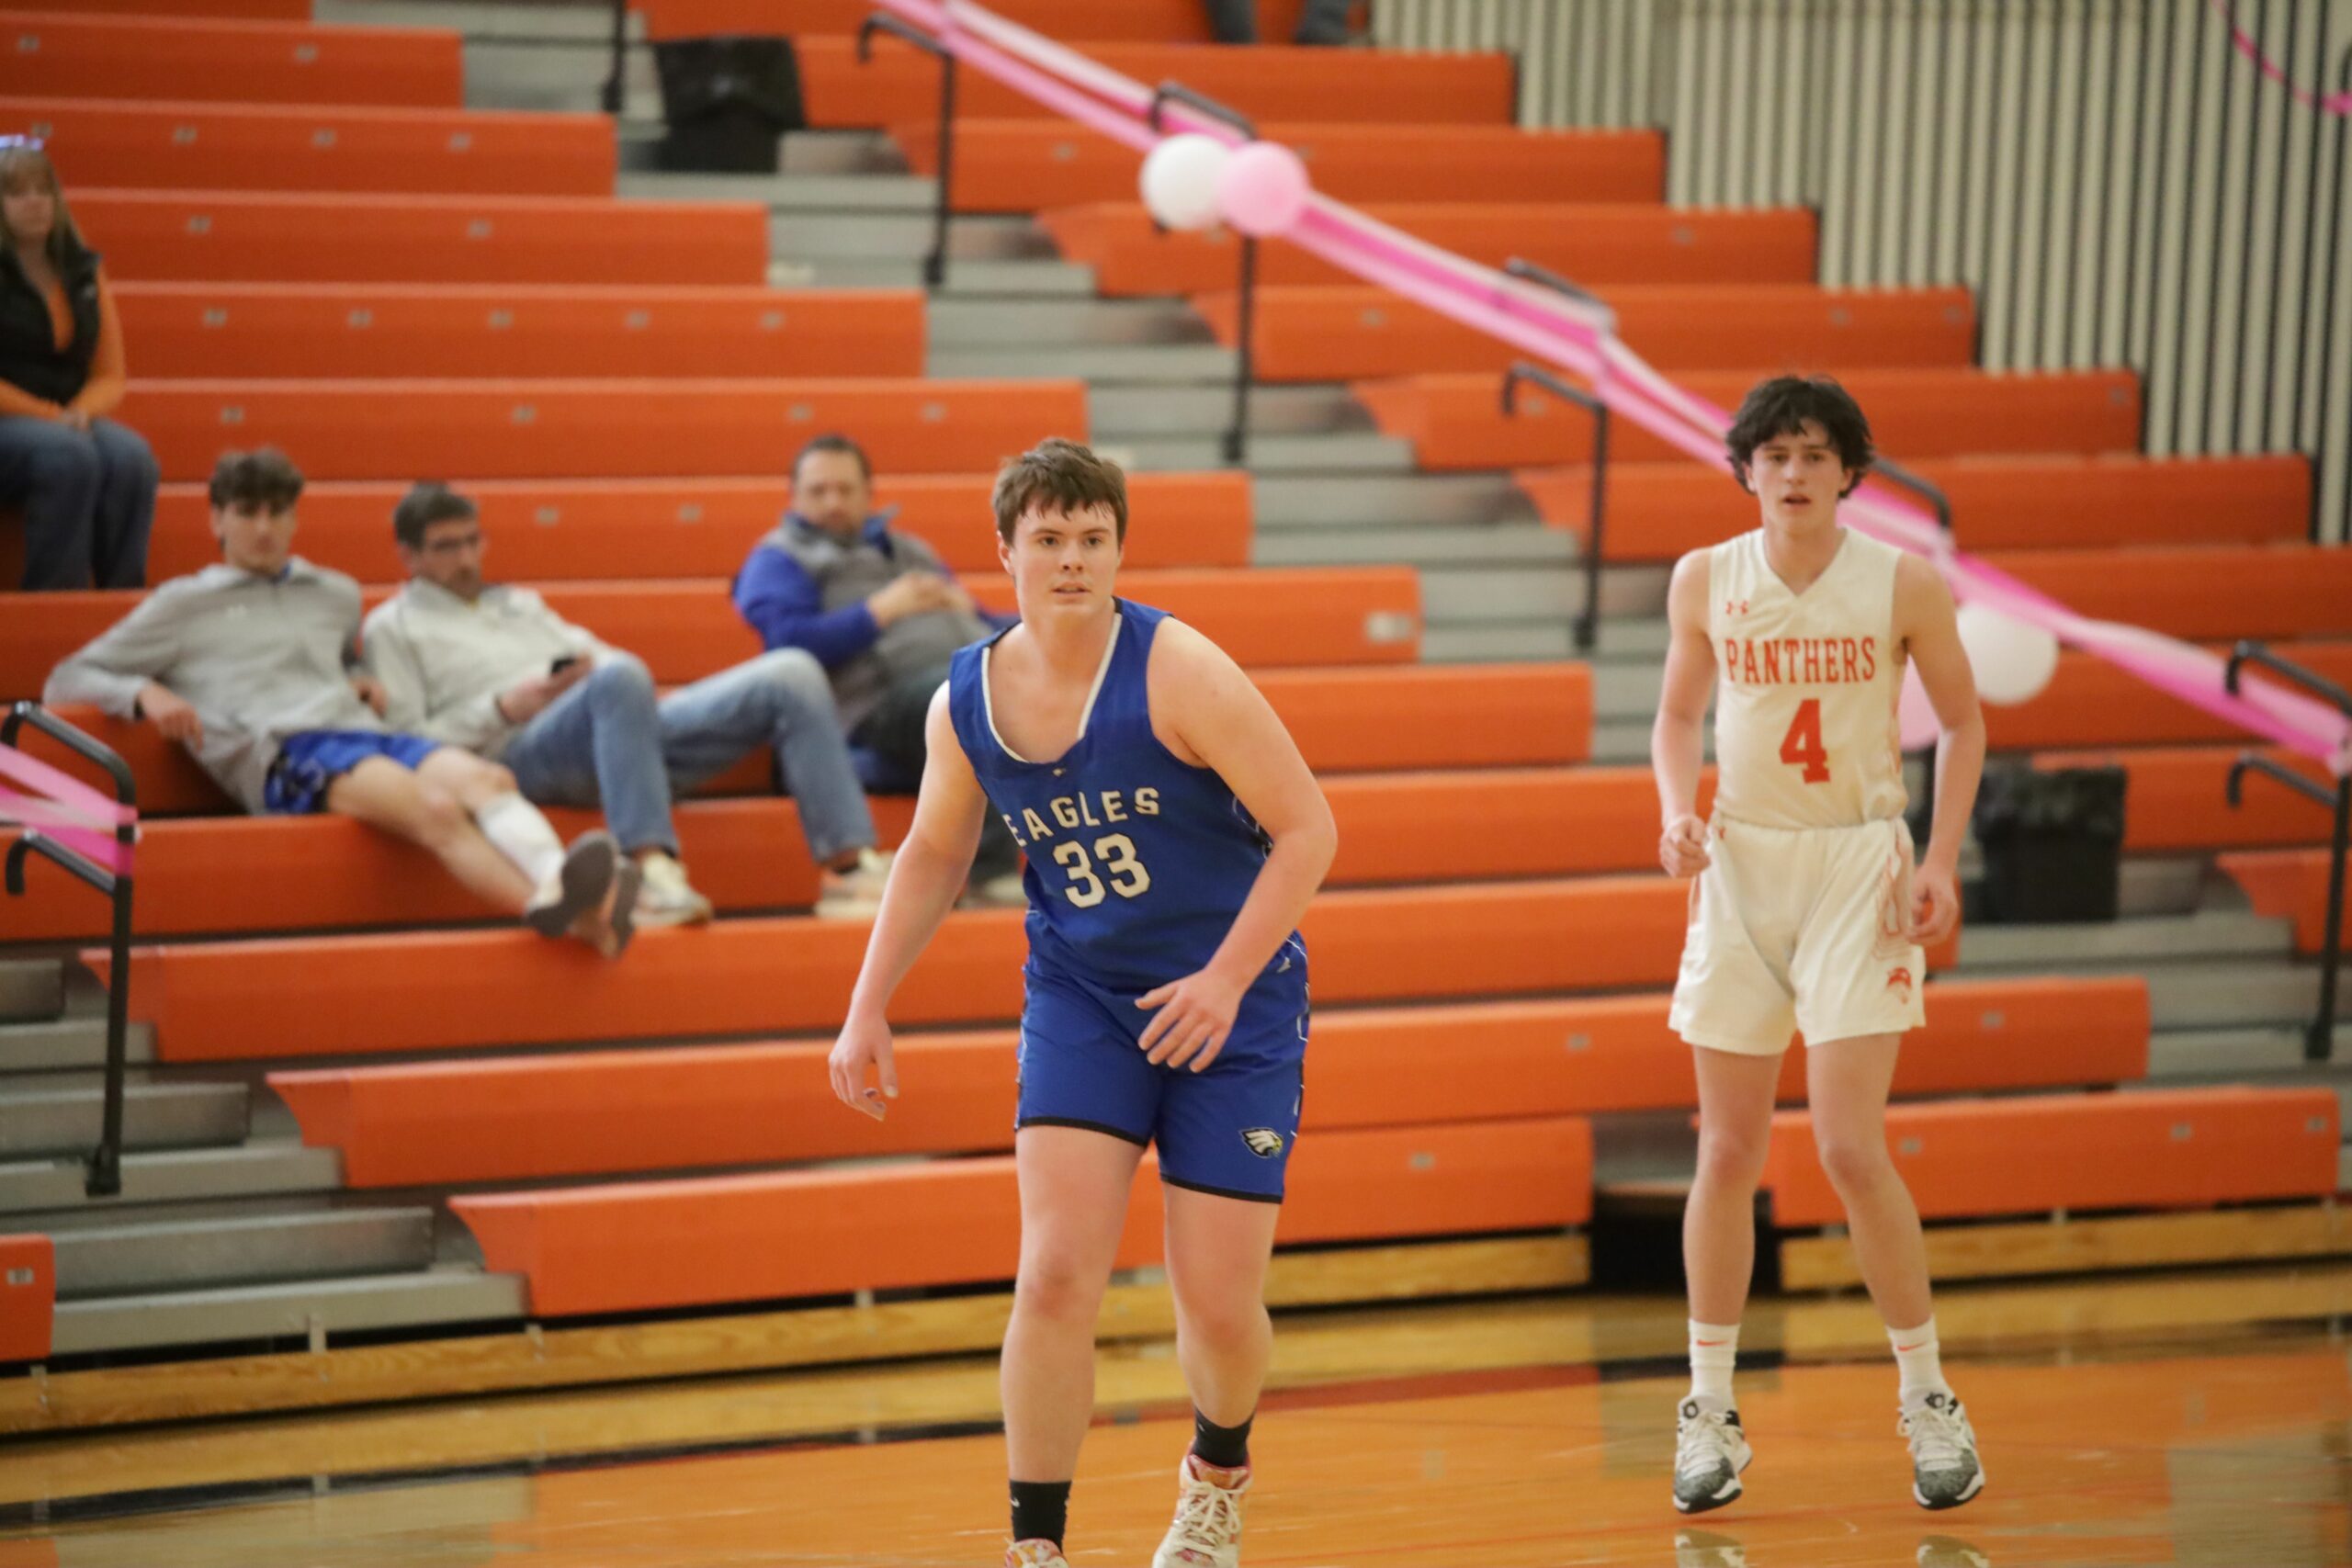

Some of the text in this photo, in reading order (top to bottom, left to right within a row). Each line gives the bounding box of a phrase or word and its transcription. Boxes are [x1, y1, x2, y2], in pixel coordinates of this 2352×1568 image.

[1725, 637, 1876, 685] PANTHERS
[1779, 697, 1830, 784] 4
[1001, 787, 1159, 847] EAGLES
[1052, 832, 1151, 908] 33
